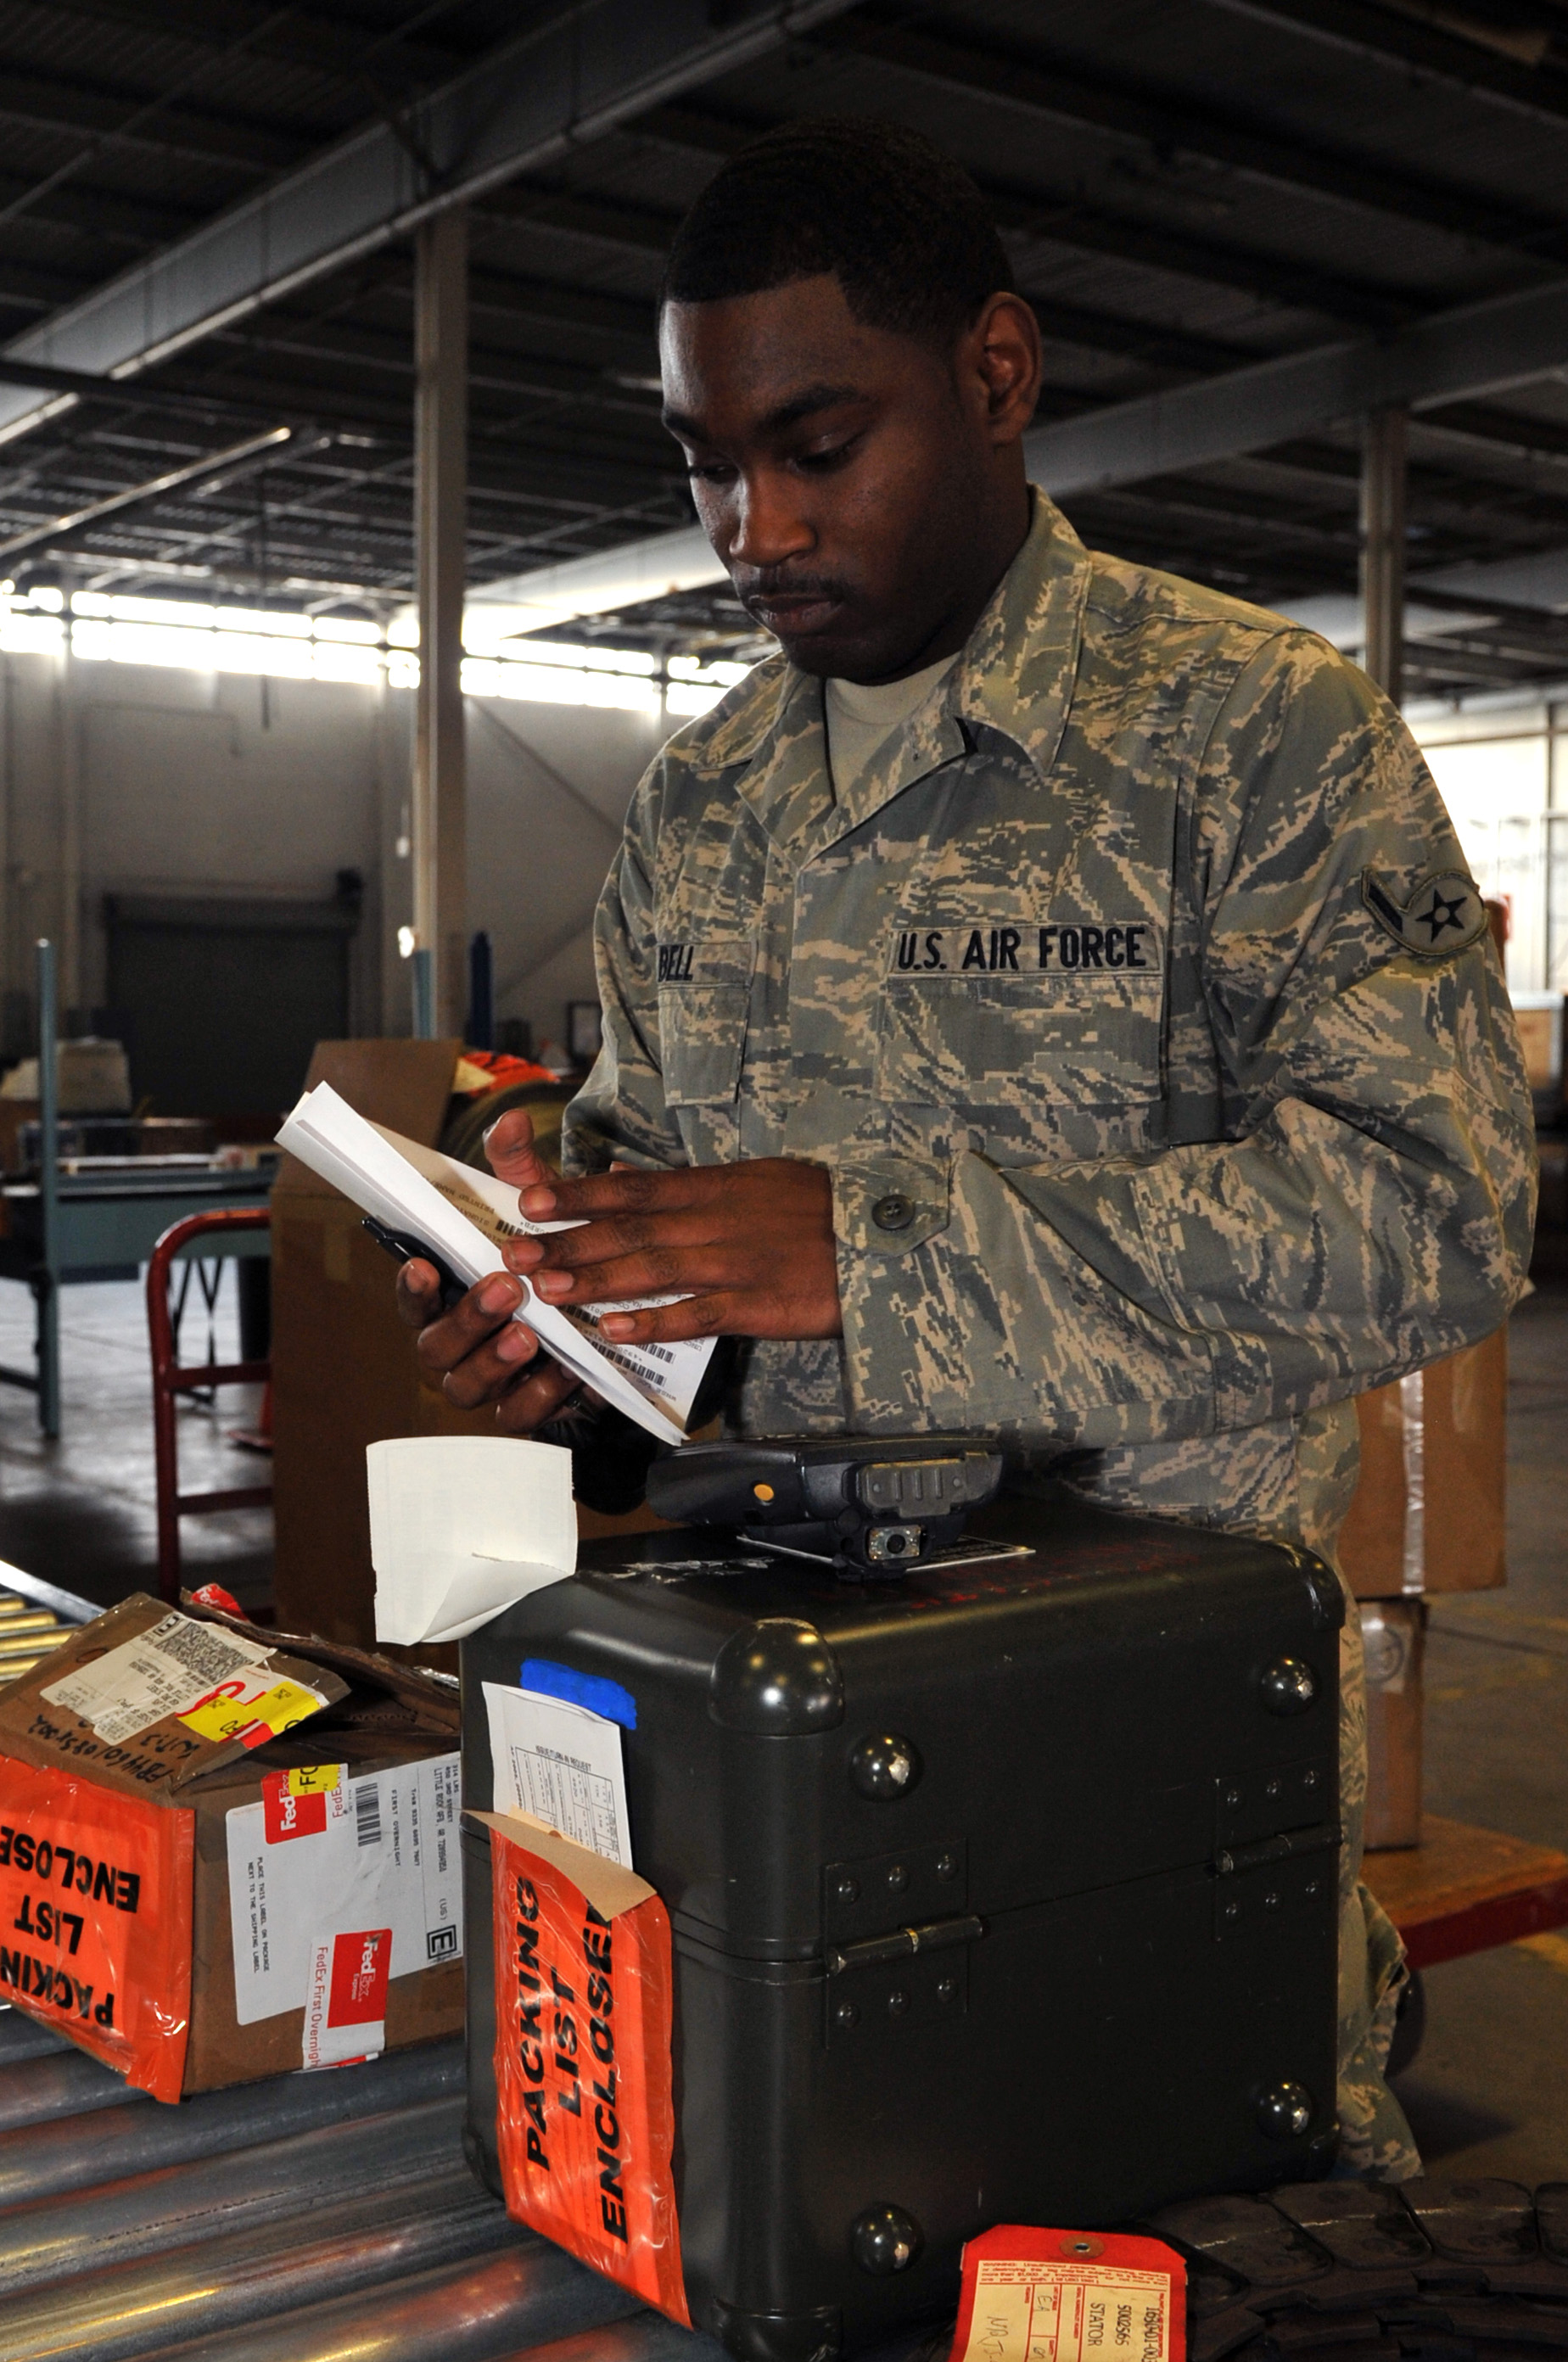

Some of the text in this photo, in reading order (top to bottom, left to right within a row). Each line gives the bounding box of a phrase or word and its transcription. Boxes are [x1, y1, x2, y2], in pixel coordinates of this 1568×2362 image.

[658, 944, 694, 982] BELL
[899, 926, 1146, 971] U.S. AIR FORCE
[434, 1767, 443, 1791] LITTLE
[0, 1826, 140, 1913] ENCLOSE
[249, 1883, 255, 1893] TO
[14, 1895, 84, 1956] LIST
[440, 1898, 448, 1920] (US)
[261, 1928, 267, 1939] ON
[315, 1946, 328, 1983] FedEx
[360, 1941, 378, 1996] FedEx
[312, 1985, 325, 2011] First
[516, 1876, 550, 2171] PACKING
[551, 1965, 581, 2118] LIST
[1087, 2303, 1106, 2347] STATOR
[1115, 2304, 1132, 2346] 5002565
